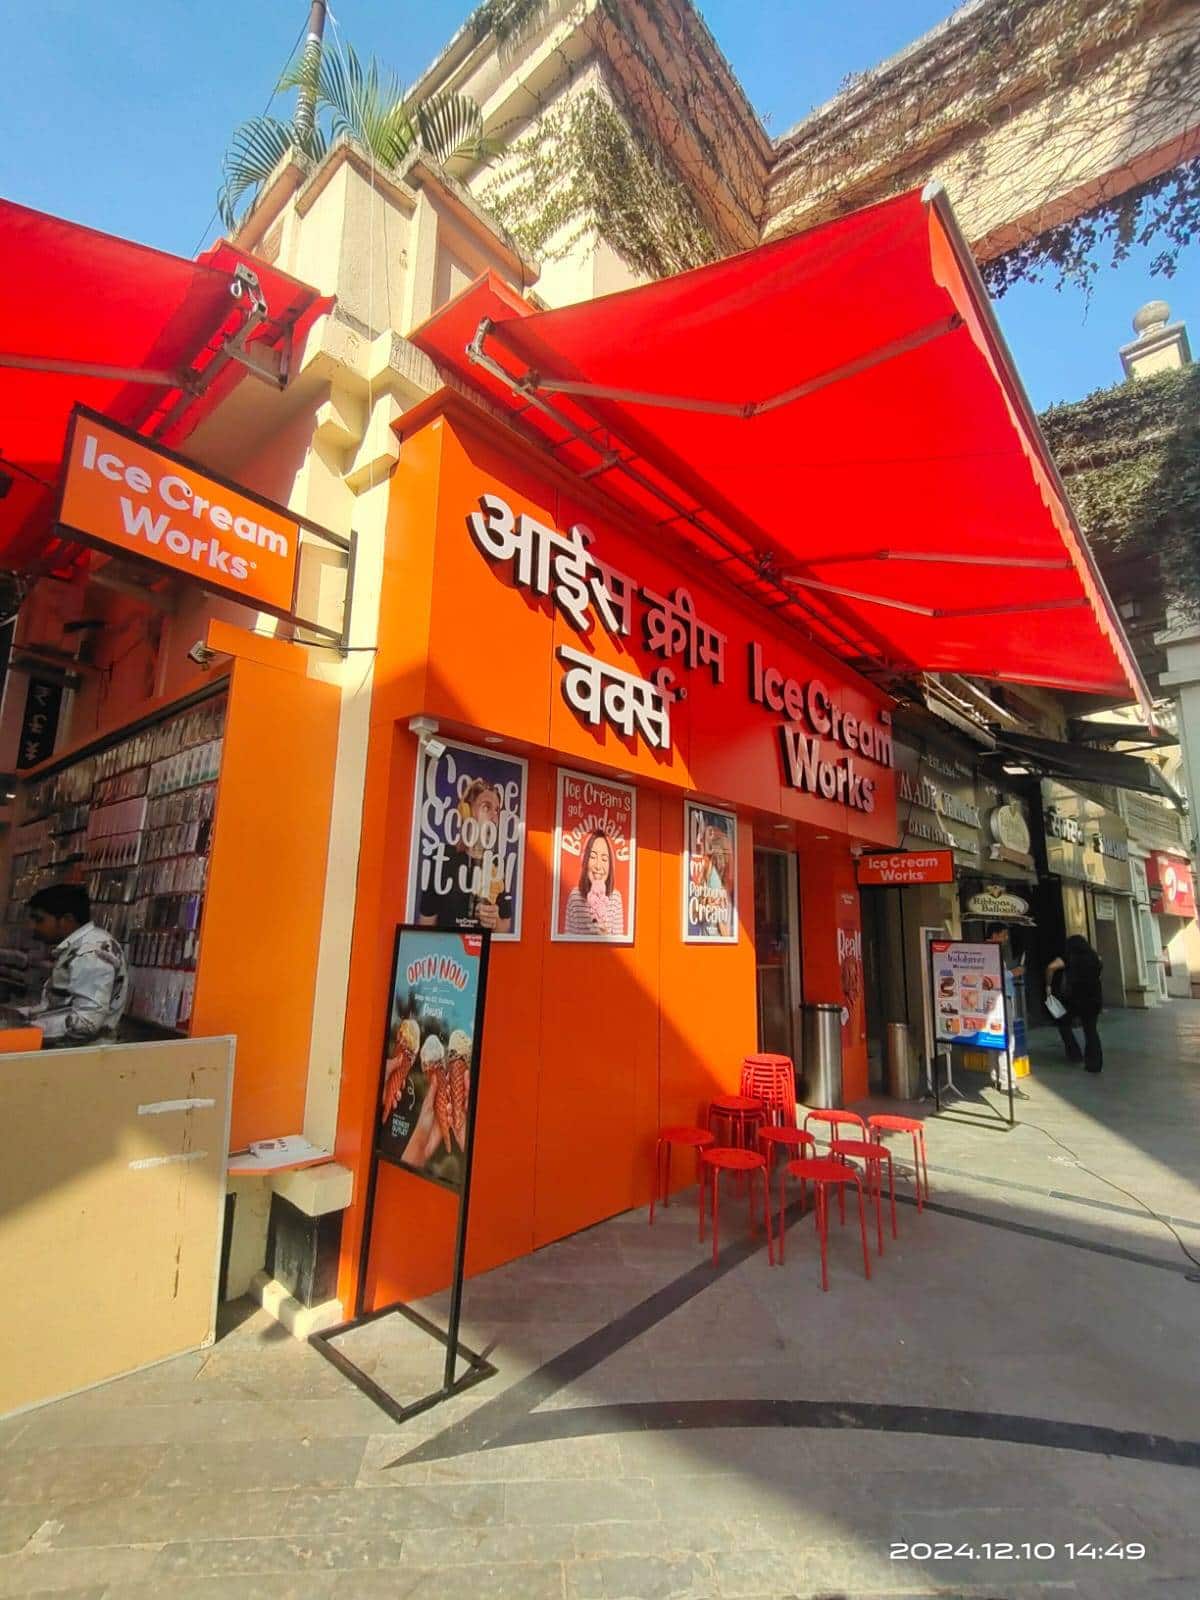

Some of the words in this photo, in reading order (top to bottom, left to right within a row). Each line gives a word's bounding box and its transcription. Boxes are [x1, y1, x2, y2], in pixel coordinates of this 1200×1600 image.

[82, 434, 152, 494] Ice
[158, 475, 288, 558] Cream
[119, 495, 249, 581] Works
[468, 493, 638, 635] आईस
[642, 587, 728, 683] क्रीम
[558, 644, 676, 749] वर्क्स
[752, 640, 803, 721] Ice
[807, 679, 894, 768] Cream
[425, 753, 520, 820] Coe
[564, 776, 582, 801] Ice
[783, 723, 875, 813] Works
[421, 796, 521, 858] Scoop
[420, 842, 454, 896] it
[868, 857, 889, 869] Ice
[889, 856, 938, 869] Cream
[880, 869, 924, 881] Works
[407, 954, 439, 985] OPEN
[439, 955, 469, 991] NOW
